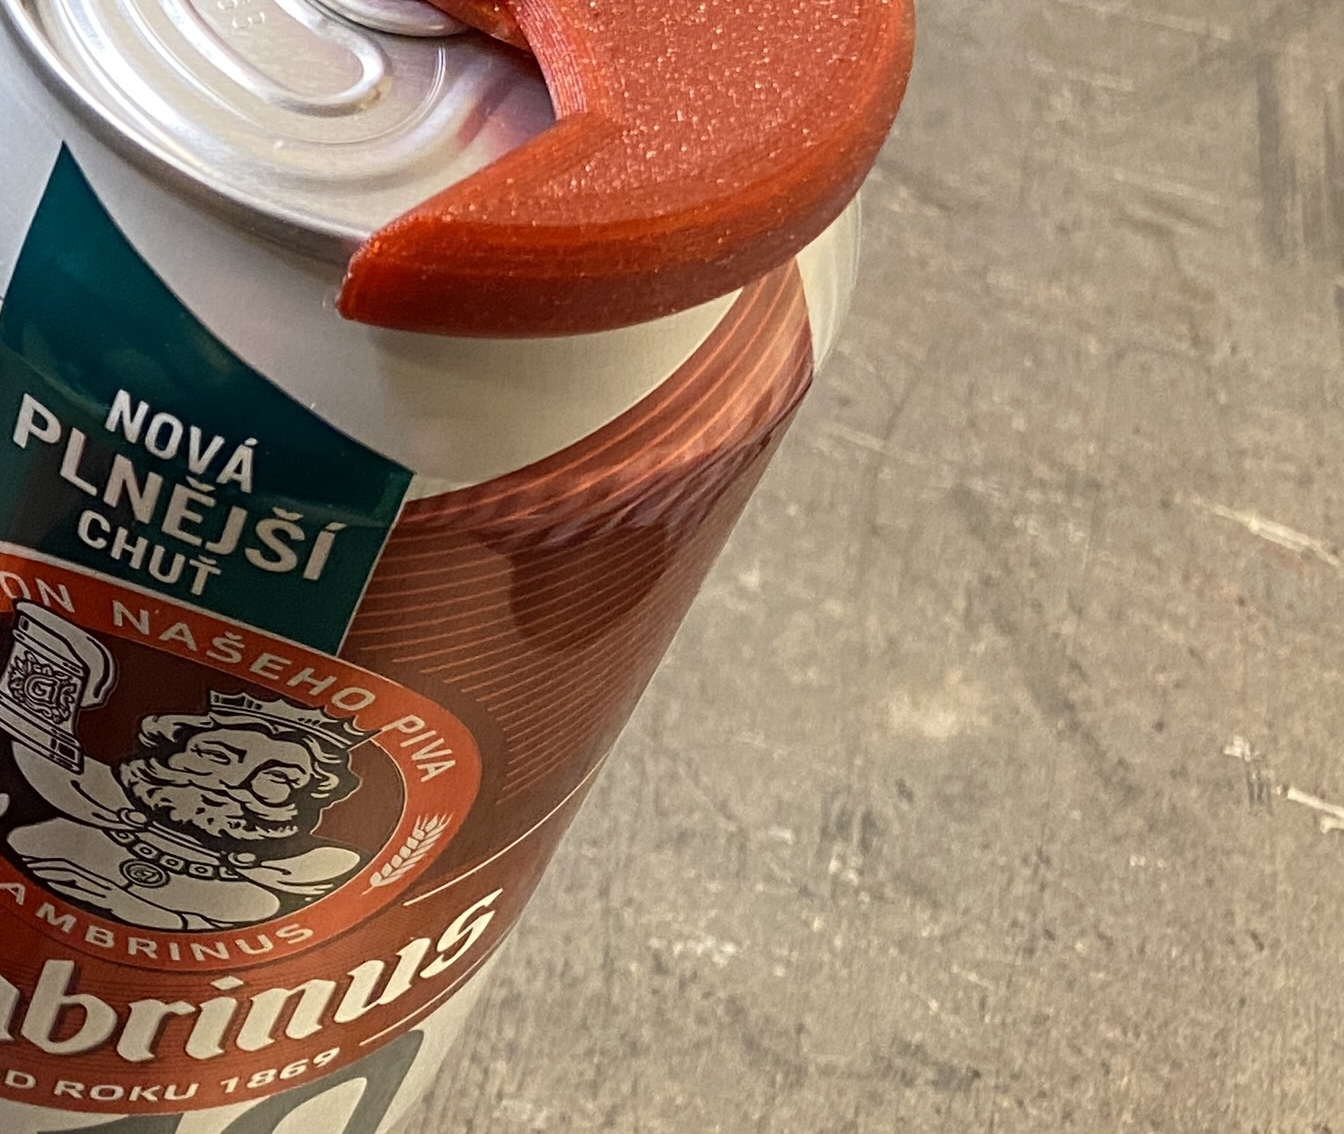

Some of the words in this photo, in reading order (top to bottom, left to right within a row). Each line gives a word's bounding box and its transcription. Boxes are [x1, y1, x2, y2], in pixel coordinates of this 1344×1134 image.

[11, 392, 348, 582] PLNĚJŠÍ
[105, 388, 260, 494] NOVÁ
[77, 509, 223, 597] CHUŤ
[111, 599, 377, 712] NAŠEHO
[379, 713, 457, 784] PIVA
[52, 1079, 200, 1103] ROKU
[220, 1046, 342, 1095] 1869
